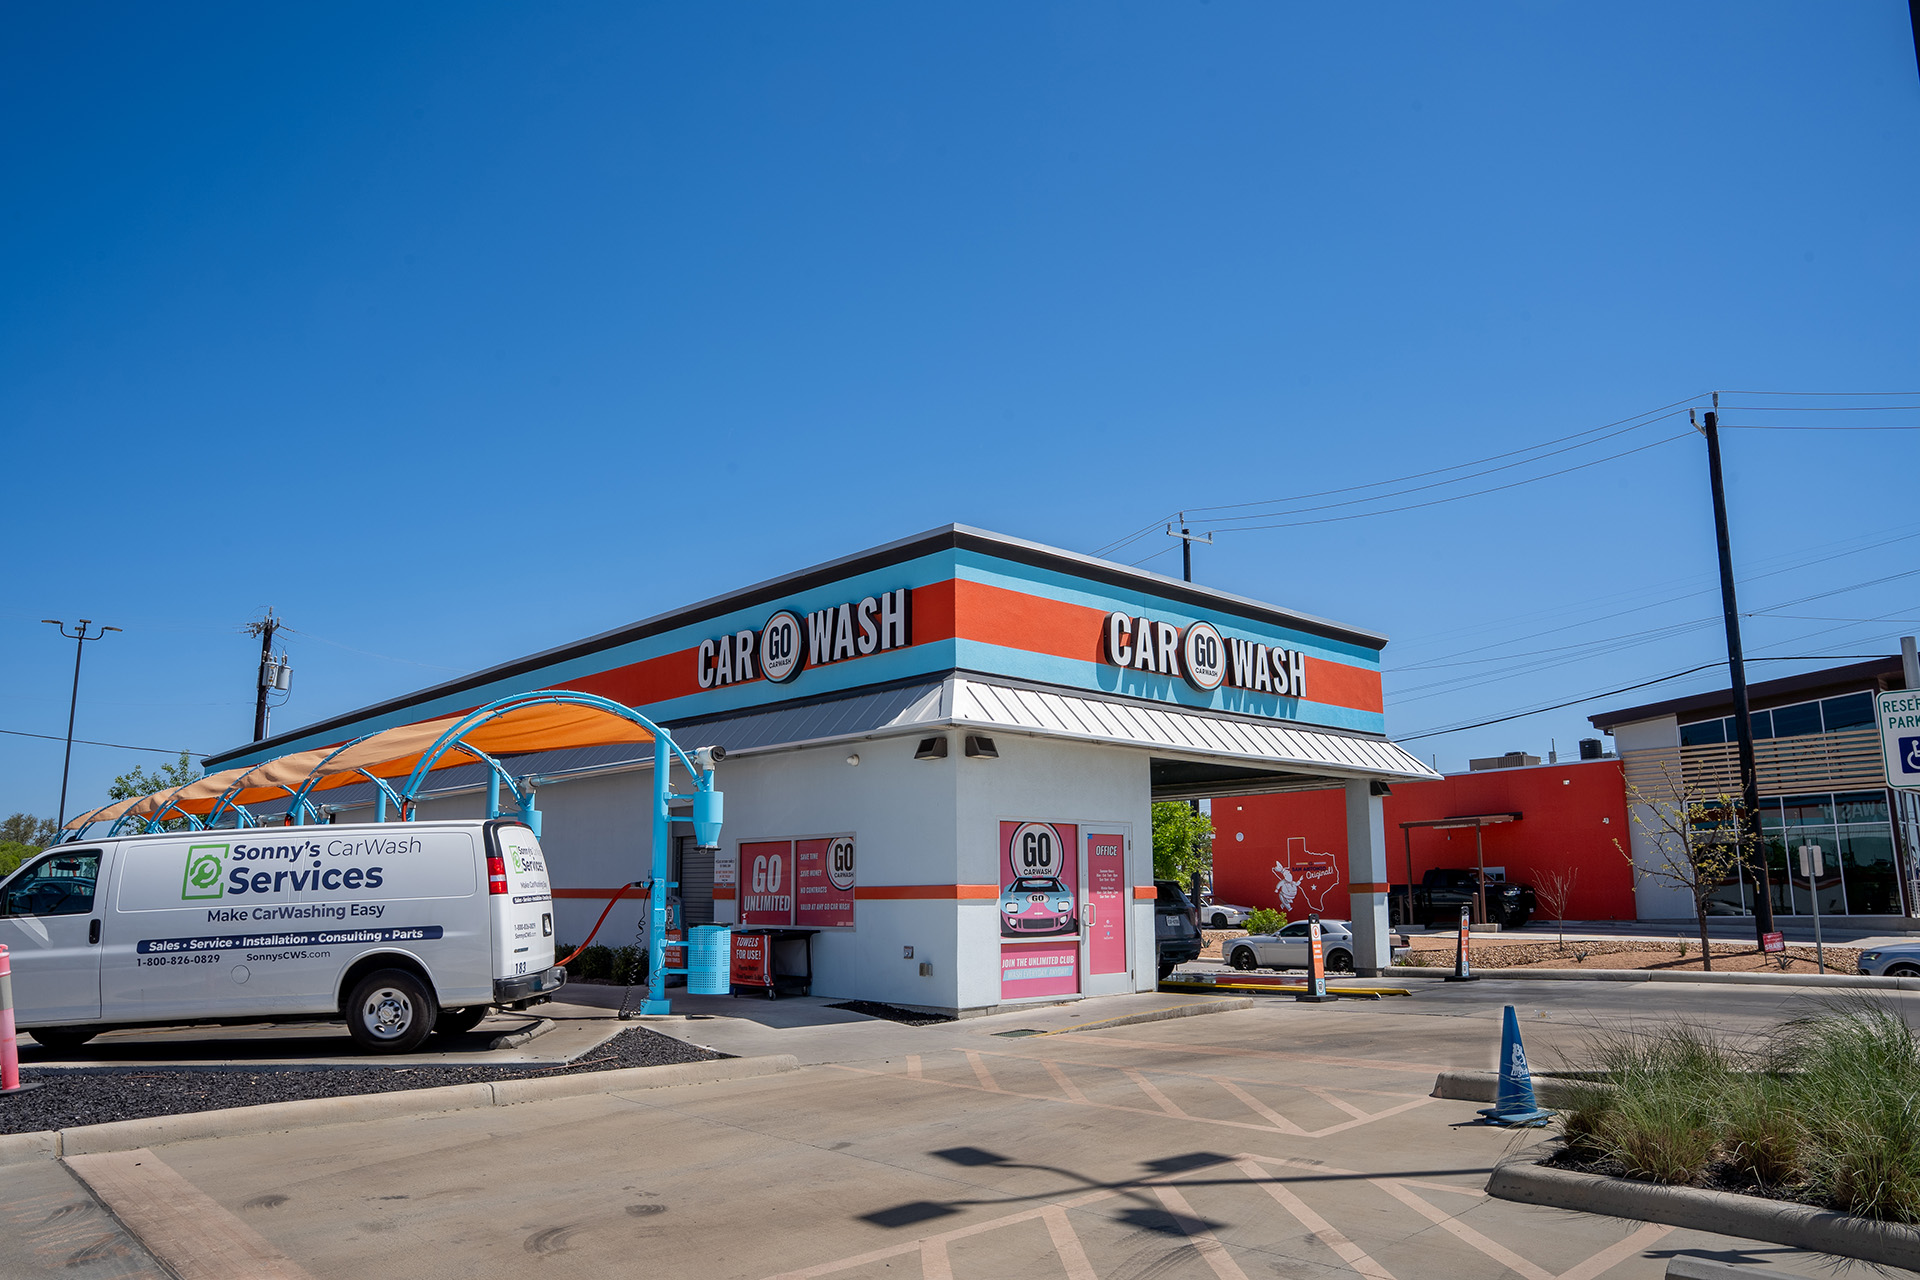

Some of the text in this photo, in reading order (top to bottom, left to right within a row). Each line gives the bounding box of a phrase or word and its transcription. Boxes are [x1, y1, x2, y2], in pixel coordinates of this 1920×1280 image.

[698, 588, 910, 689] CAR WASH
[769, 623, 791, 661] GO
[1106, 611, 1307, 698] CAR WASH
[1194, 633, 1218, 669] GO
[769, 658, 792, 669] CARWASH
[1195, 667, 1218, 678] CARWASH
[232, 836, 422, 863] Sonny's CarWash
[834, 843, 853, 871] GO
[1023, 832, 1052, 867] GO
[1095, 845, 1118, 856] OFFICE
[227, 860, 384, 895] Services
[752, 854, 782, 893] GO
[1023, 868, 1052, 876] CARWASH
[207, 903, 385, 923] Make CarWashing Easy
[744, 895, 791, 912] UNLIMITED
[149, 928, 424, 952] Sales Service Installation Consulting Parts
[736, 937, 760, 947] TOWELS
[136, 950, 331, 967] 1-800-826-0829 SonnysCWS.com
[736, 949, 761, 960] FOR USE!
[1002, 955, 1075, 968] JOIN THE UNLIMITED CLUB
[515, 961, 527, 974] 183
